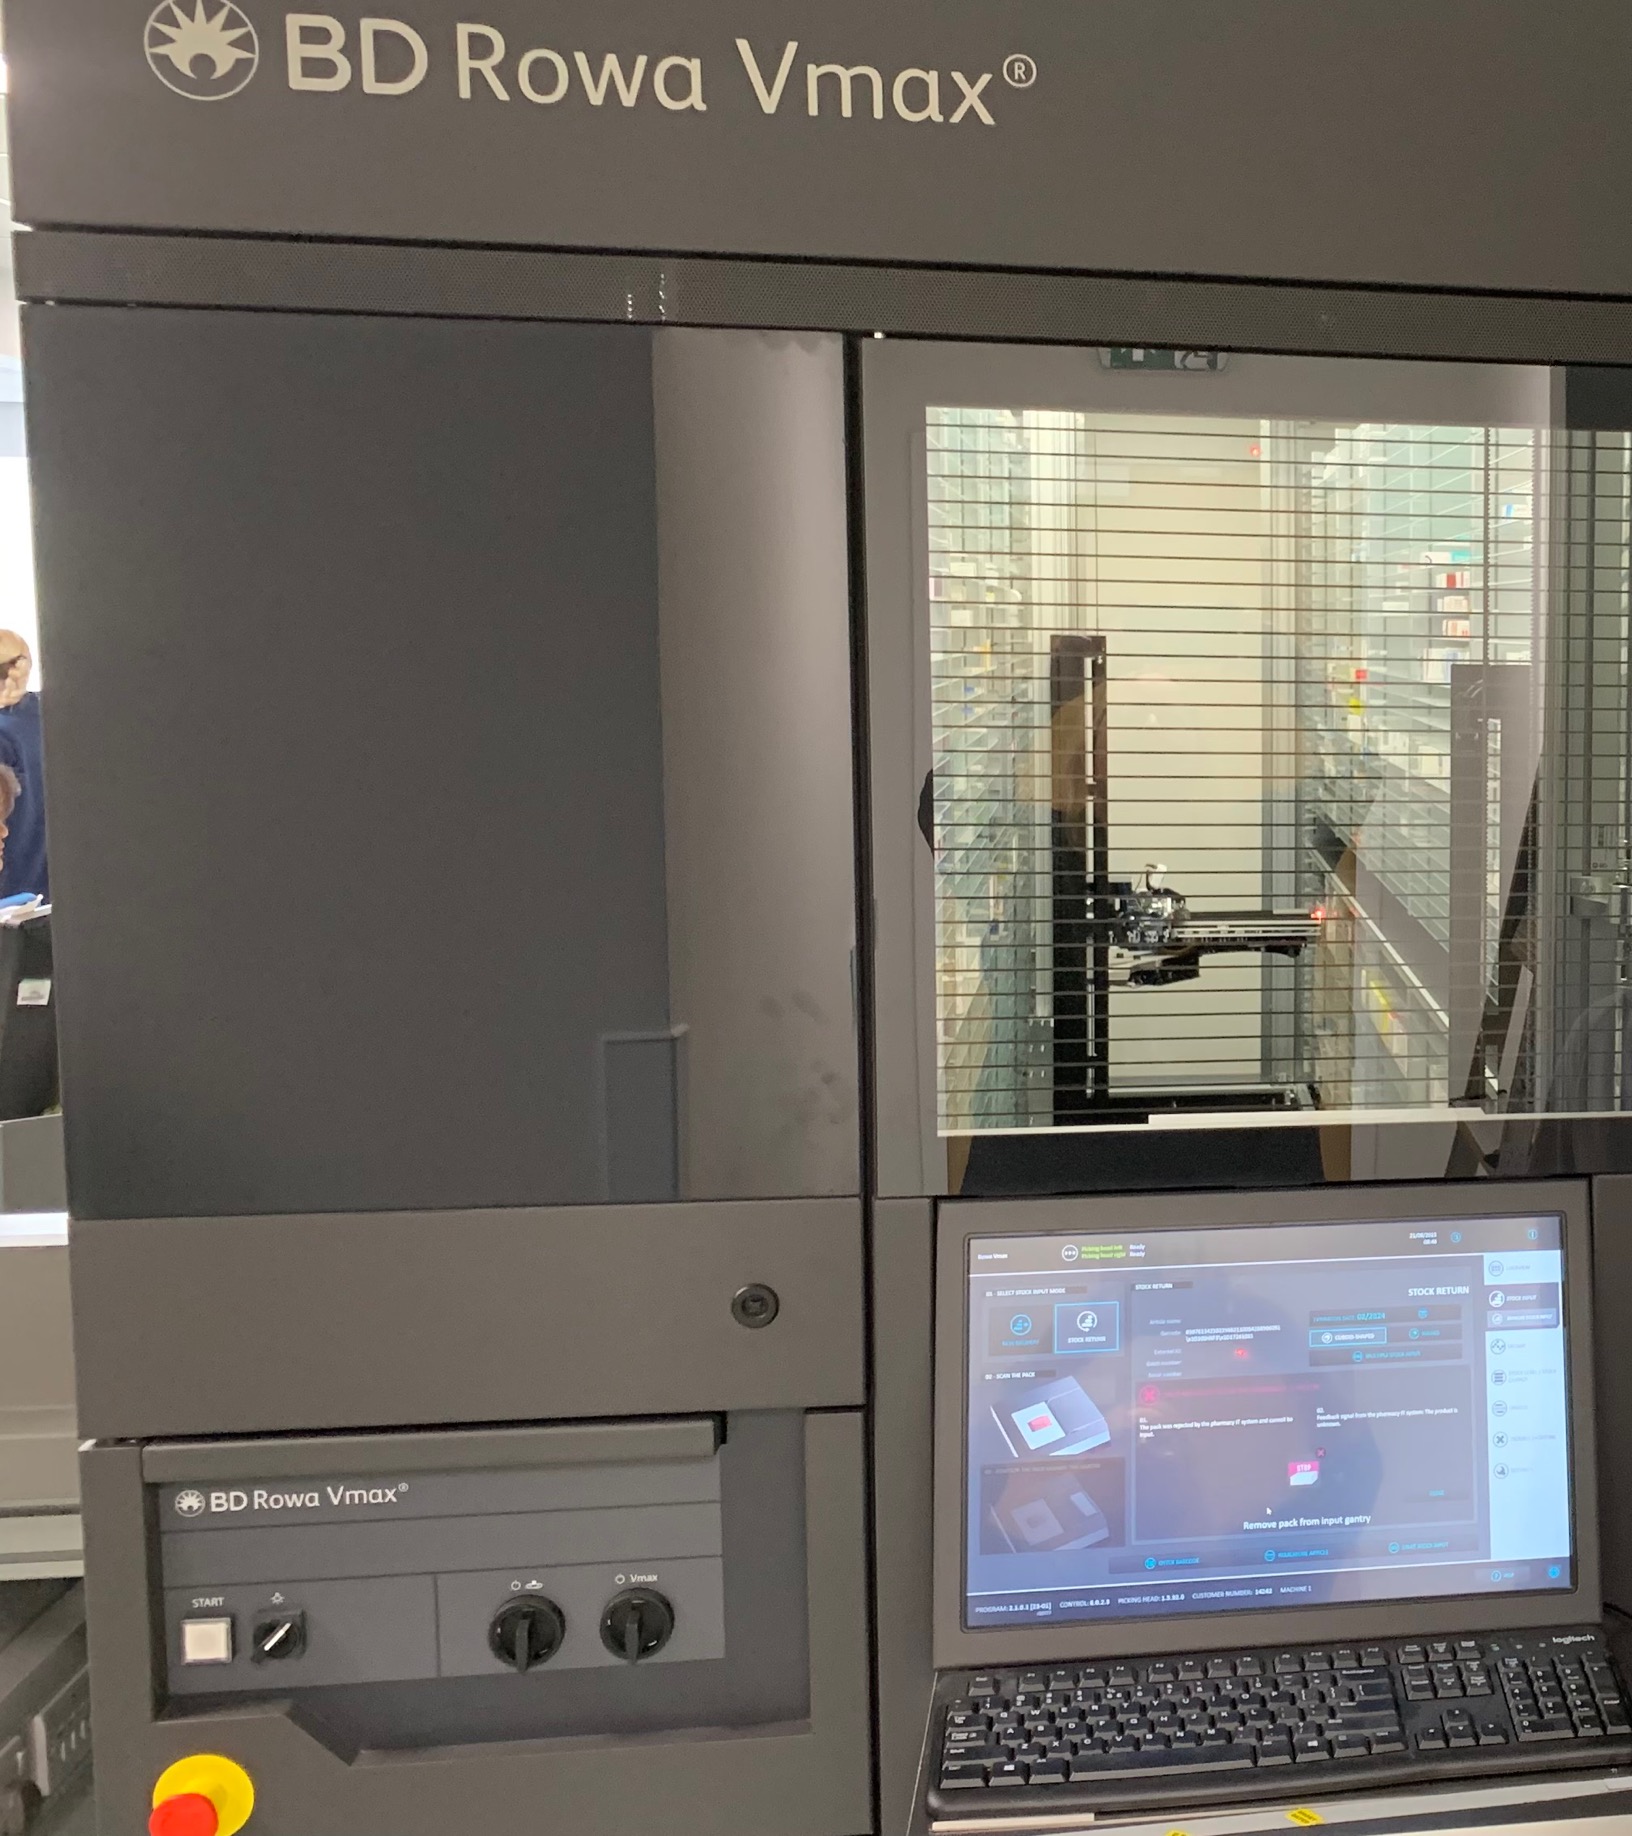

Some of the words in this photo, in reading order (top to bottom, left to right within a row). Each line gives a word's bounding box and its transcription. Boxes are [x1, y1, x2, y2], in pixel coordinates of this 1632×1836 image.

[285, 13, 428, 95] BD
[456, 22, 707, 111] Rowa
[1408, 1287, 1435, 1296] STOCK
[1436, 1286, 1470, 1295] RETURN
[210, 1491, 247, 1513] BD
[253, 1490, 320, 1510] Rowa
[1243, 1520, 1277, 1531] Remove
[1278, 1517, 1298, 1530] pack
[1300, 1517, 1320, 1527] from
[1321, 1516, 1343, 1526] input
[1344, 1514, 1371, 1526] gantry
[630, 1574, 658, 1583] Vmax
[192, 1597, 224, 1608] START
[1552, 1634, 1595, 1645] logitech
